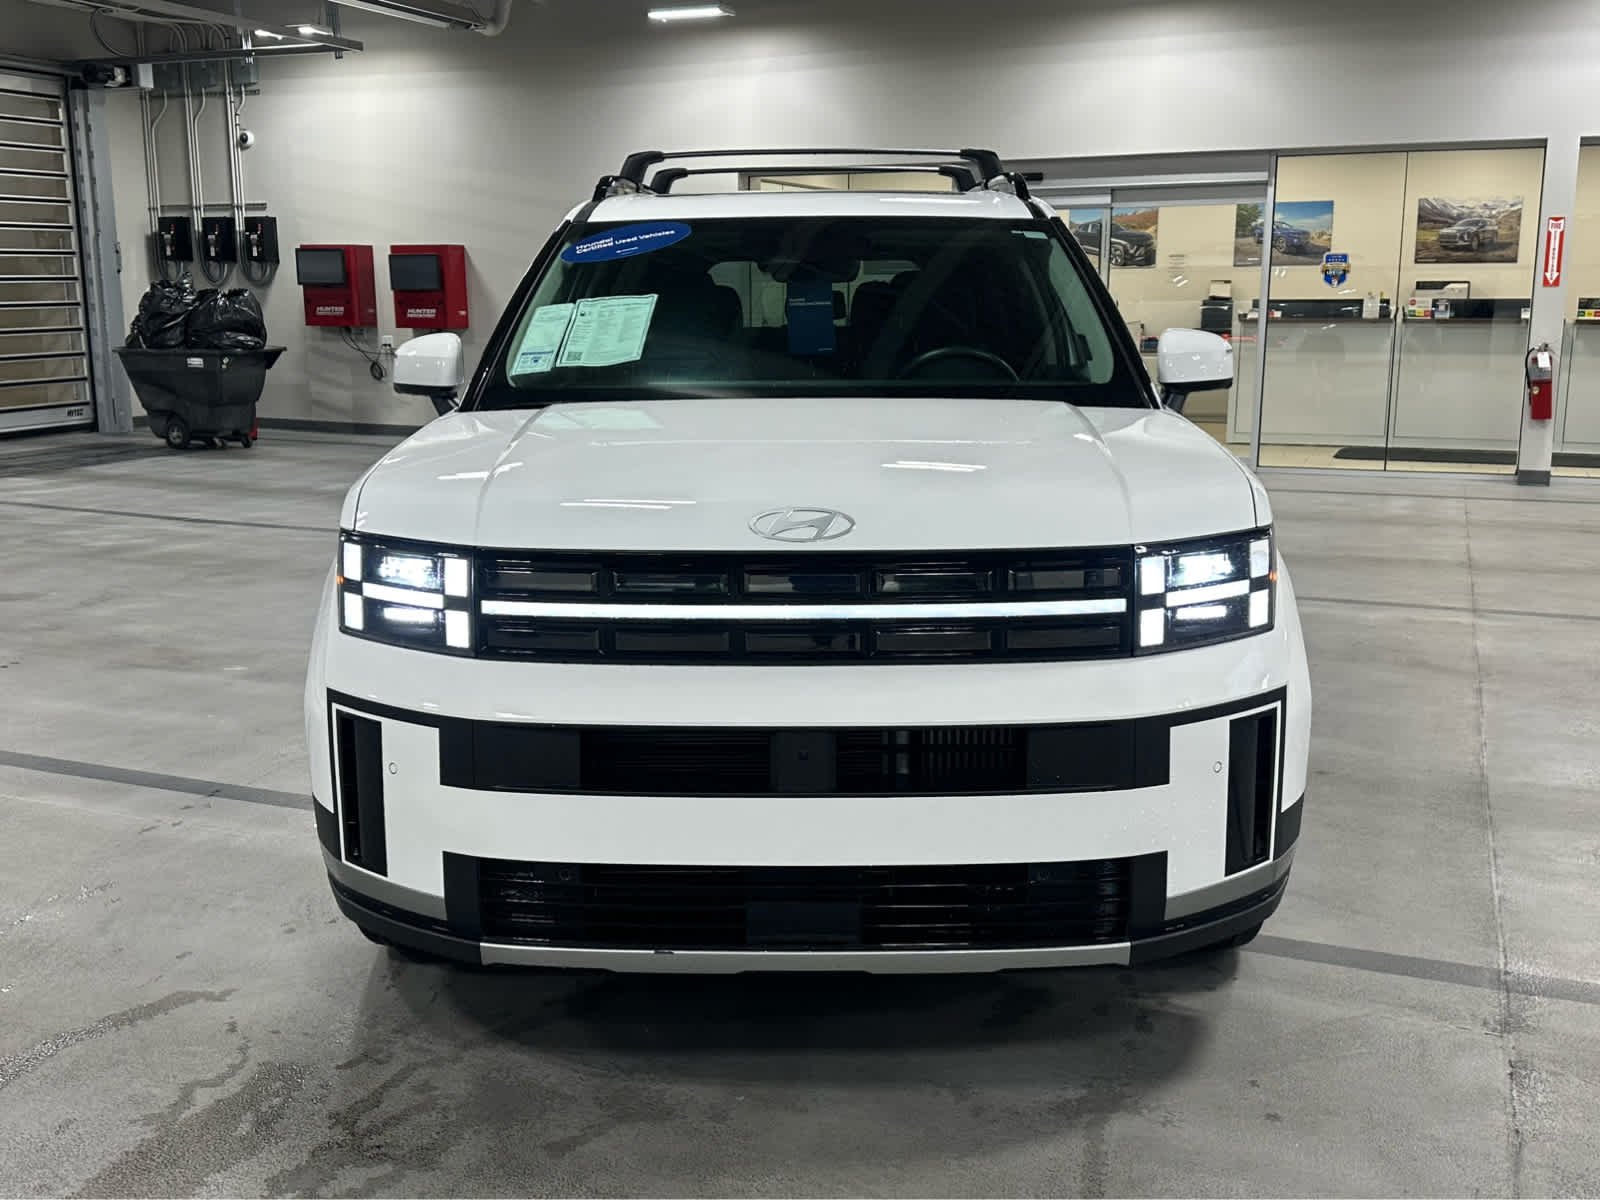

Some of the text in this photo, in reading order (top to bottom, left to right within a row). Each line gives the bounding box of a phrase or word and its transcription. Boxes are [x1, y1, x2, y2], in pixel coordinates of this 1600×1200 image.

[575, 241, 614, 254] Certified
[615, 236, 638, 245] Used
[639, 230, 675, 240] Vehicles
[575, 237, 613, 250] Hyundai
